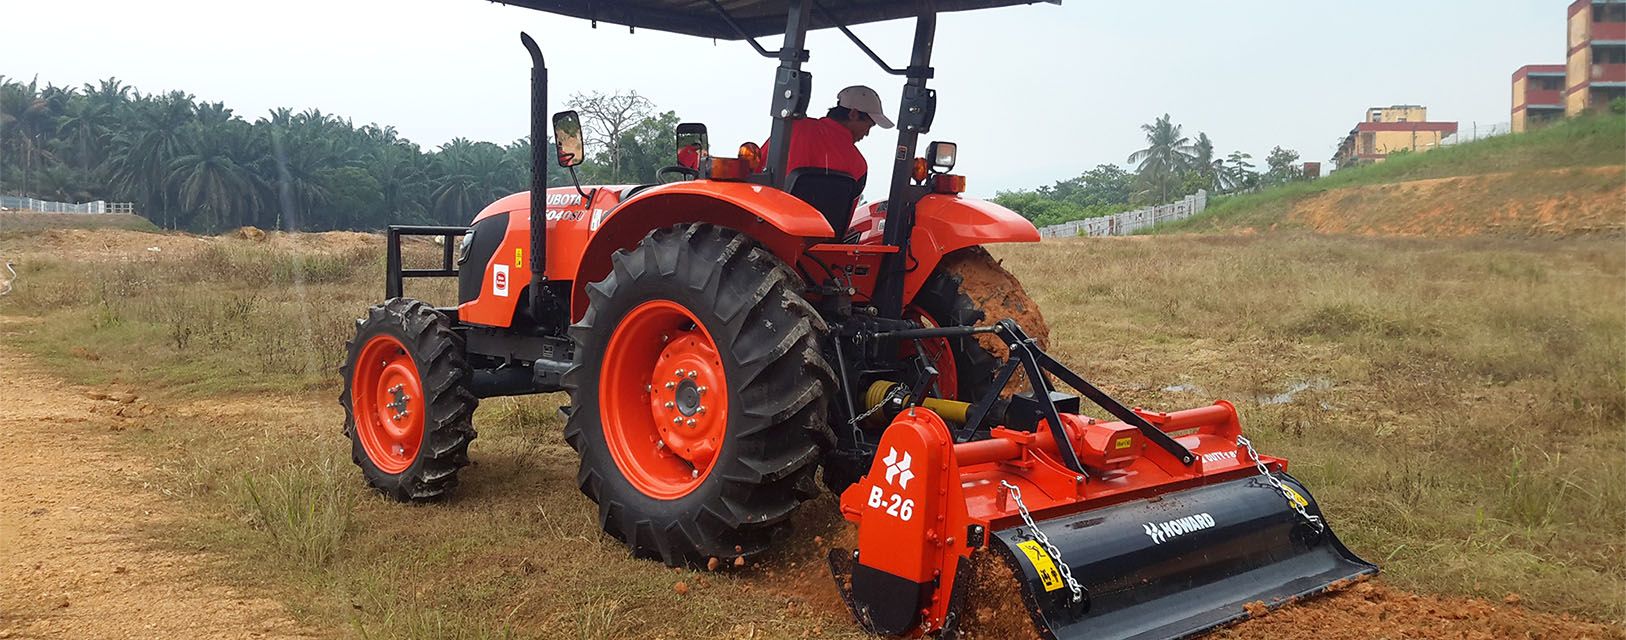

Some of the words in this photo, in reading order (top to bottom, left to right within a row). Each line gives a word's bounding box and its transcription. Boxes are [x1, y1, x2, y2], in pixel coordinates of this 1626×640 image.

[546, 193, 582, 206] UBOTA
[868, 485, 915, 521] B-26
[1159, 512, 1216, 538] HOWARD
